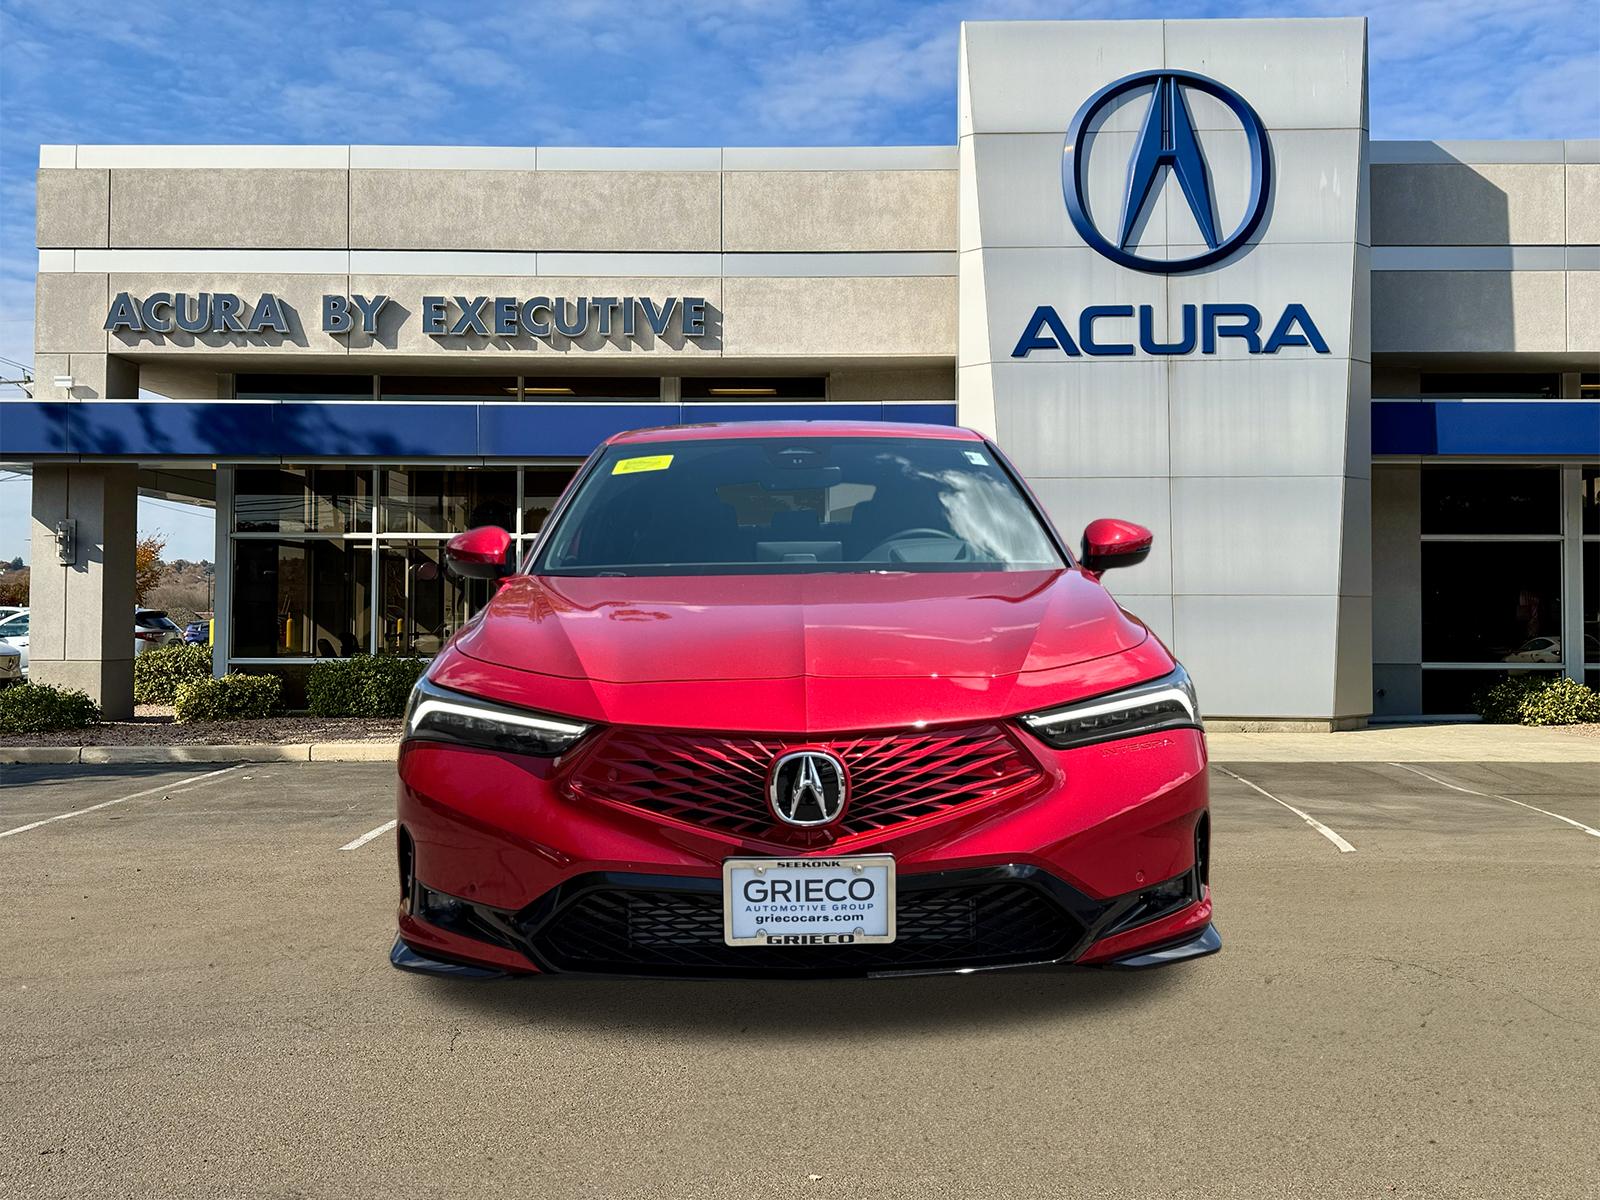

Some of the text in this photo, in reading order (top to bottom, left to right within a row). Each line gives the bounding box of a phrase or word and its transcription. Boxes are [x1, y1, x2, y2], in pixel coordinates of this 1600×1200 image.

[104, 292, 708, 337] ACURA BY EXECUTIVE
[1011, 304, 1333, 357] ACURA
[1100, 738, 1176, 757] INTEGRA
[743, 878, 875, 903] GRIECO
[745, 903, 874, 912] AUTOMOTIVE GROUP
[755, 914, 864, 924] griecocars.com
[766, 934, 854, 944] GRIECO
